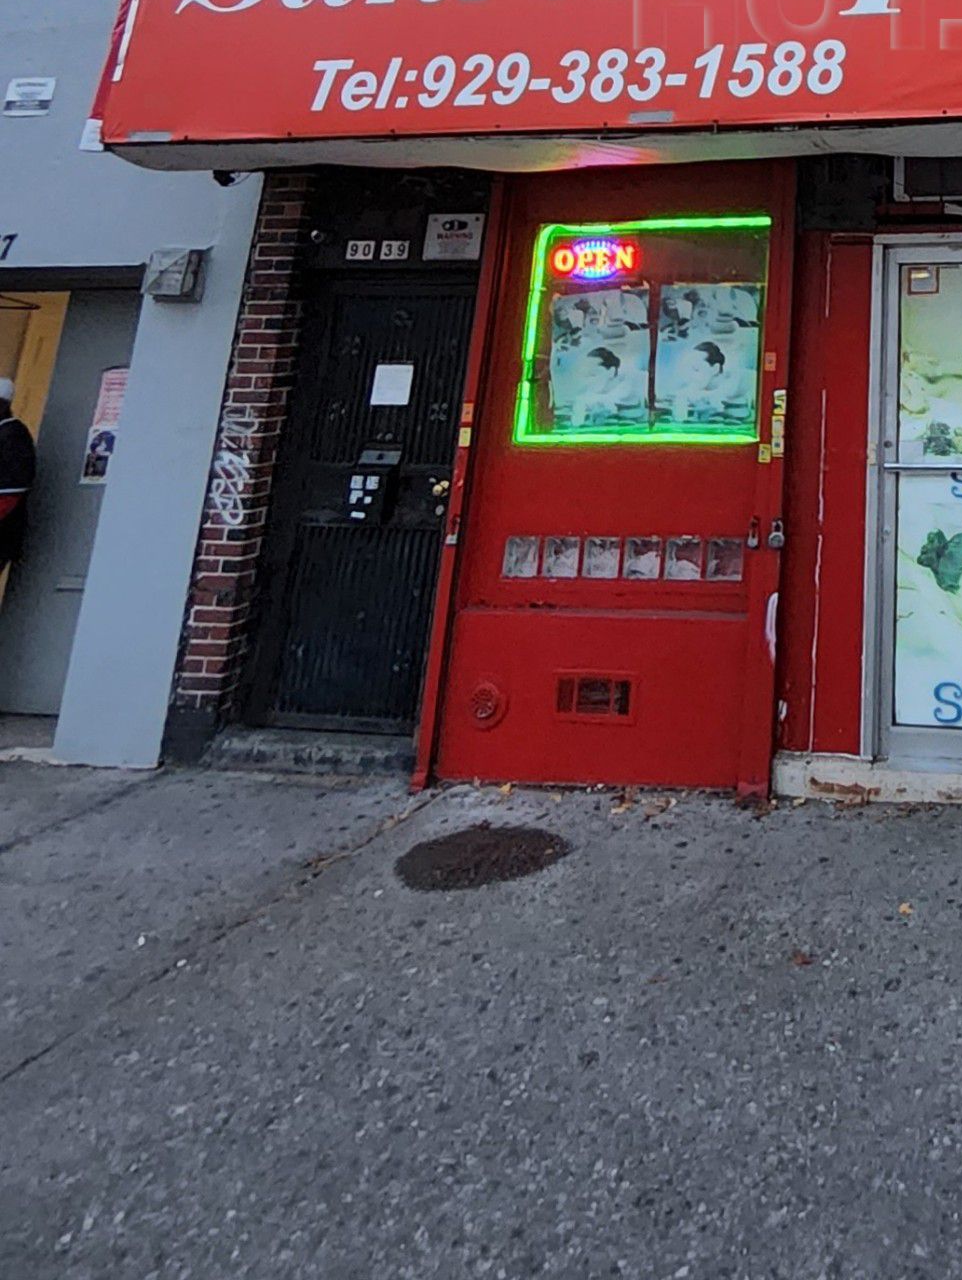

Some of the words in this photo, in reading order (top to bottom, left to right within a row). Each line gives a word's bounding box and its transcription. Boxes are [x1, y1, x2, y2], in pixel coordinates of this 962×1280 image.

[309, 38, 847, 113] Tel:929-383-1588
[0, 233, 19, 260] 7
[553, 244, 636, 272] OPEN
